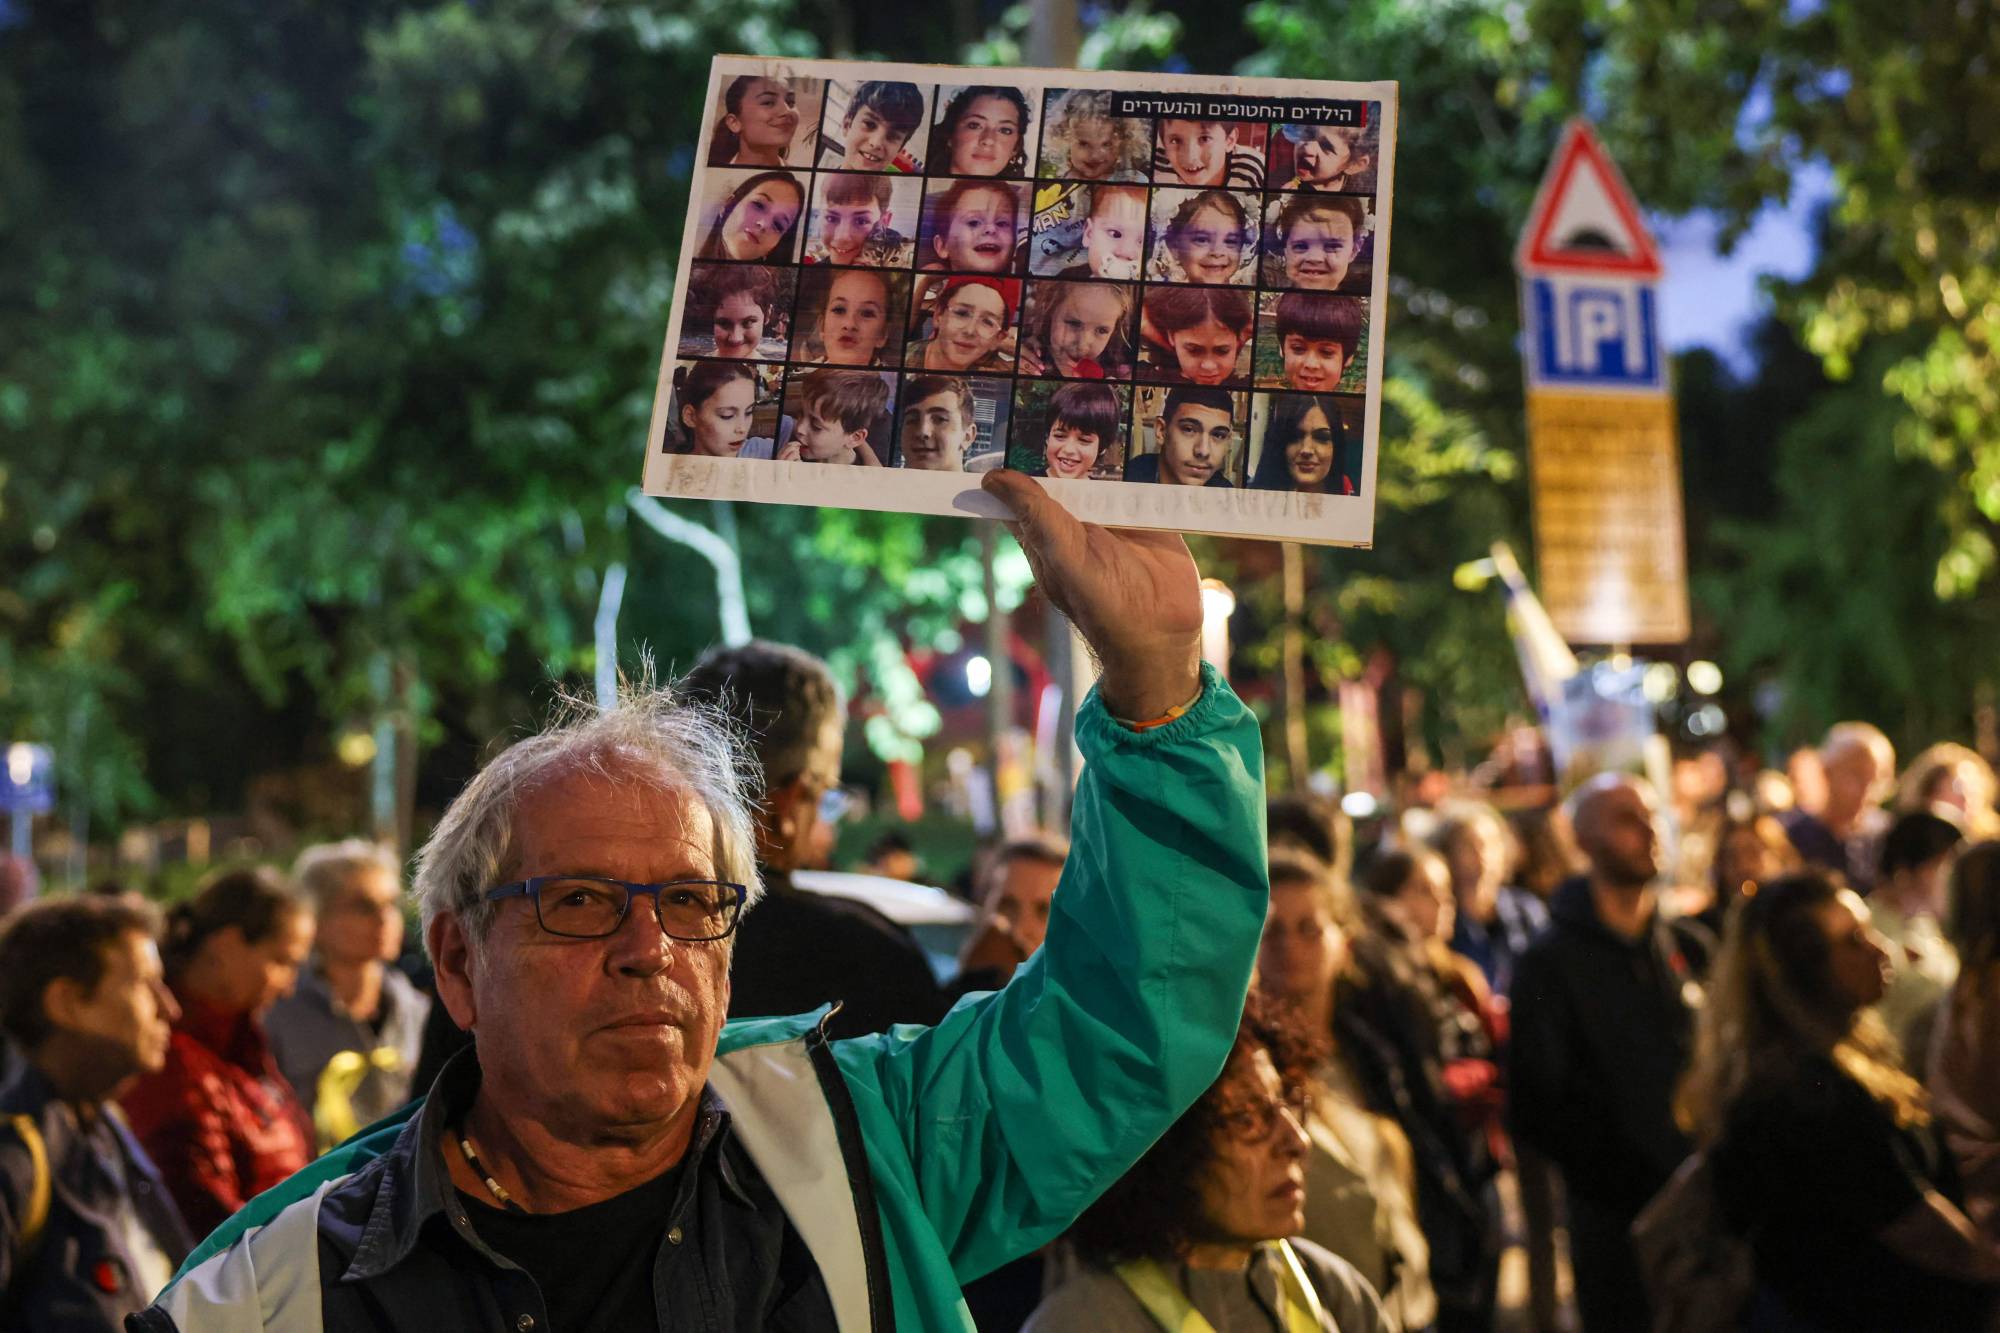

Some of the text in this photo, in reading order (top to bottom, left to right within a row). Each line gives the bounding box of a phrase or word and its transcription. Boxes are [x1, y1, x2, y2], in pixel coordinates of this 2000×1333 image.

[1122, 100, 1353, 122] הילדים החטופים והנעדרים
[1578, 300, 1620, 374] P
